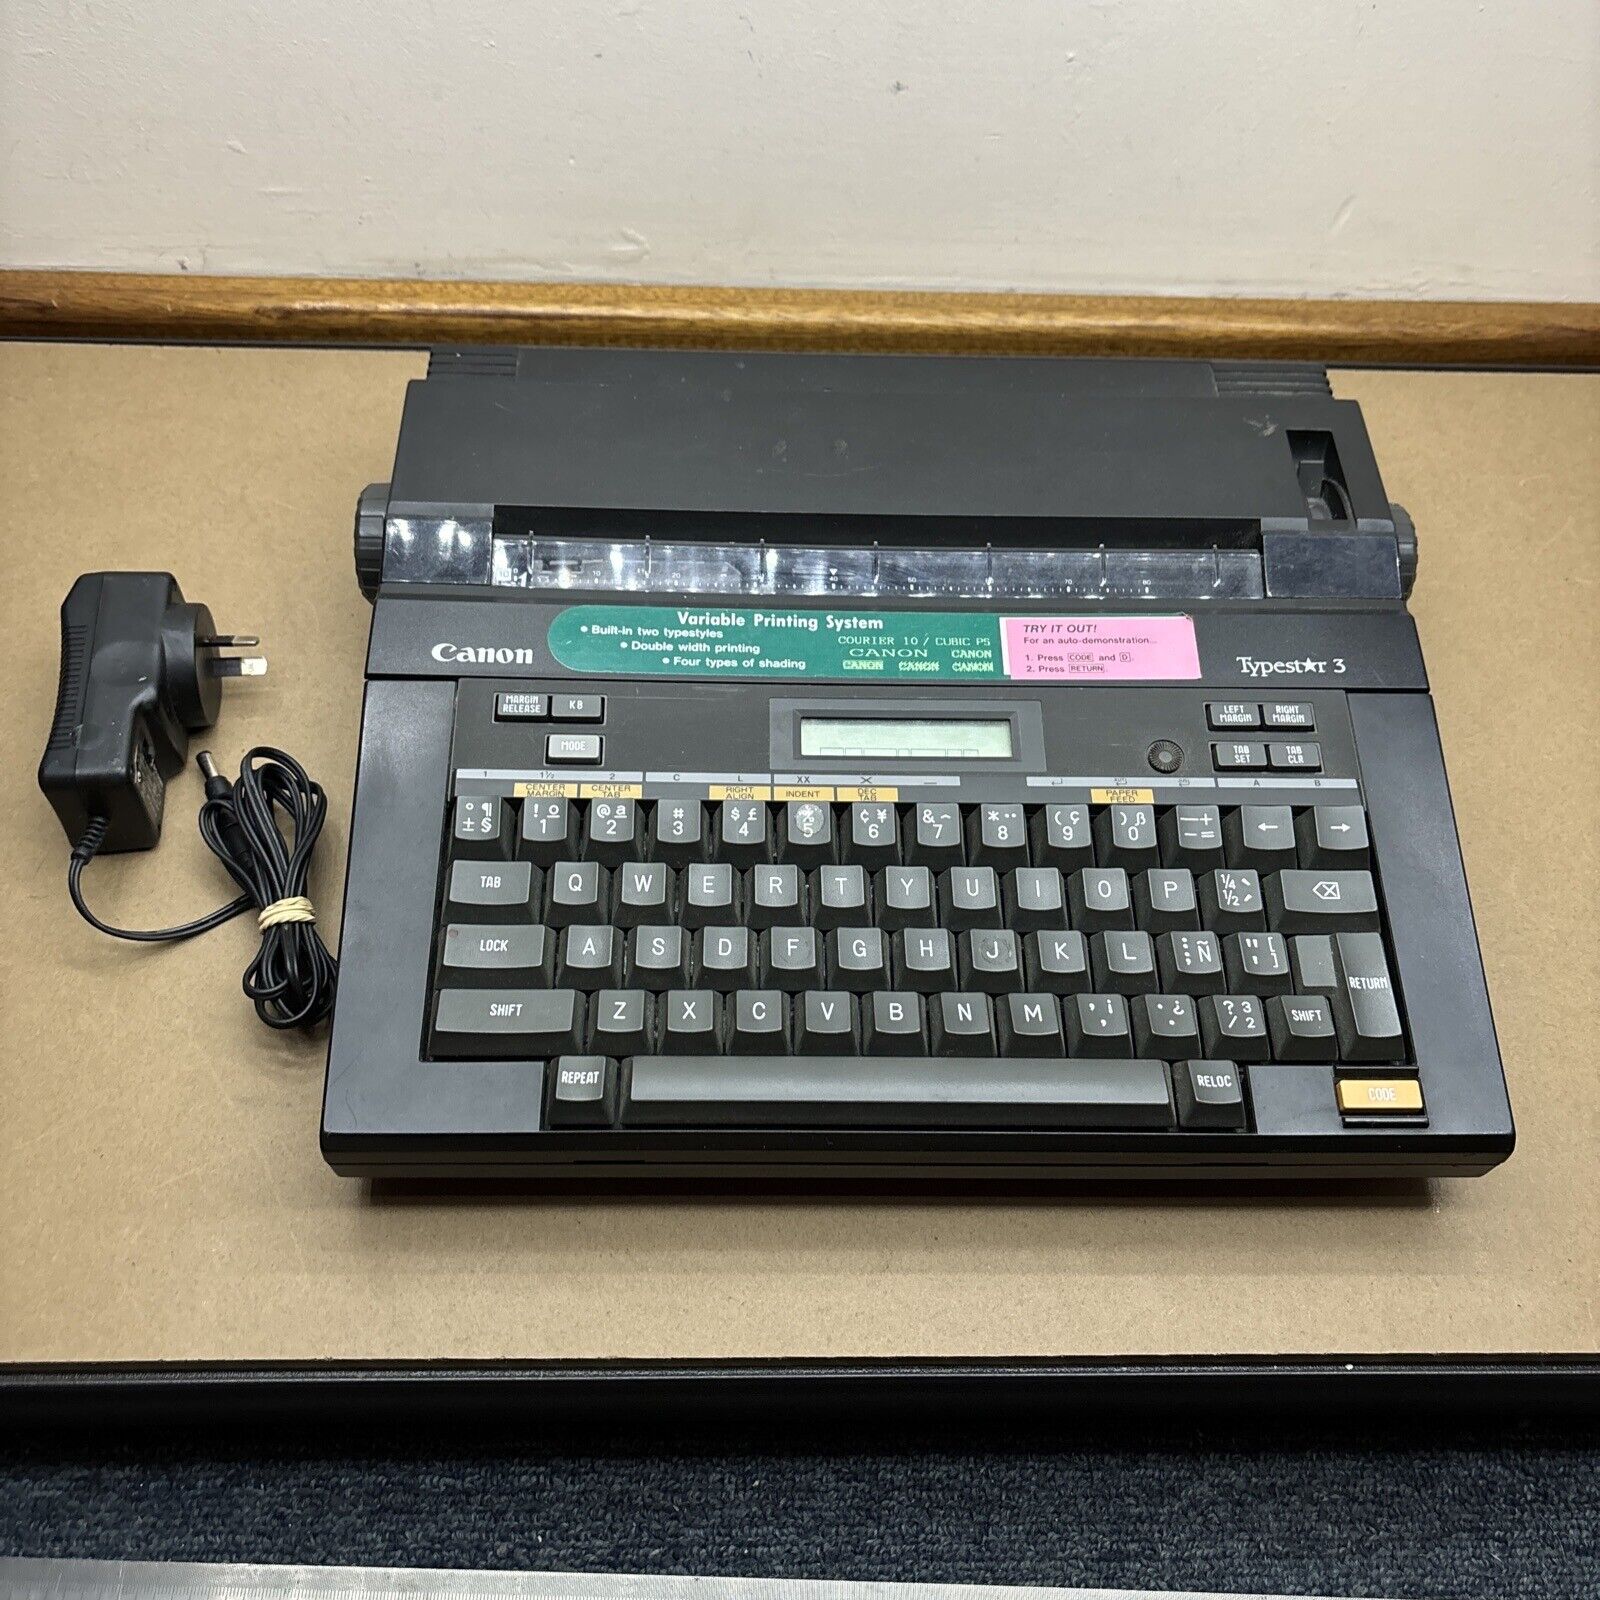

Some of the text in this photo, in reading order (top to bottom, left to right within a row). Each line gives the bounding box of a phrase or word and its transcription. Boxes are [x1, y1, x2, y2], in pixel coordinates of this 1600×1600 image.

[677, 611, 883, 631] Variable Printing System
[592, 625, 723, 639] Built-in two typestyles
[1024, 624, 1097, 633] TRY IT OUT!
[631, 641, 760, 655] Double width printing
[838, 636, 894, 645] COURIER
[904, 637, 918, 646] 10
[936, 637, 970, 646] CUBIC
[976, 638, 991, 646] PS
[432, 643, 533, 665] Canon
[850, 649, 928, 658] CANON
[952, 650, 992, 659] CANON
[673, 657, 806, 670] Four types of shading
[843, 660, 884, 670] CANON
[899, 661, 939, 672] CANON
[952, 662, 994, 672] CANON
[1027, 665, 1035, 673] 2.
[1333, 659, 1346, 673] 3
[506, 695, 538, 704] MARGIN
[503, 704, 541, 713] RELEASE
[1224, 705, 1244, 714] LEFT
[1276, 705, 1299, 714] RIGHT
[1220, 714, 1252, 722] MARGIN
[1273, 714, 1305, 723] MARGIN
[561, 741, 586, 751] MODE
[1233, 745, 1250, 754] TAB
[1286, 746, 1302, 754] TAB
[1235, 755, 1250, 763] SET
[1288, 755, 1304, 764] CLR
[797, 776, 810, 784] XX
[1253, 779, 1260, 787] A
[786, 790, 820, 798] INDENT
[597, 804, 611, 818] @
[673, 808, 684, 819] #
[731, 807, 740, 821] $
[922, 809, 935, 823] &
[540, 819, 547, 834] 1
[607, 820, 617, 835] 2
[673, 822, 684, 836] 3
[739, 822, 749, 836] 4
[803, 823, 813, 838] 5
[868, 824, 879, 839] 6
[933, 824, 943, 839] 7
[997, 826, 1008, 840] 8
[1063, 826, 1073, 841] 9
[480, 876, 501, 888] TAB
[568, 874, 582, 892] Q
[634, 874, 653, 892] W
[703, 876, 715, 894] E
[769, 877, 783, 894] R
[835, 878, 848, 895] T
[901, 879, 914, 896] Y
[966, 879, 979, 897] U
[1036, 880, 1041, 898] I
[1098, 880, 1112, 898] O
[1164, 881, 1178, 899] P
[480, 940, 509, 952] LOCK
[582, 938, 596, 956] A
[652, 938, 665, 956] S
[718, 938, 732, 956] D
[787, 939, 800, 957] F
[852, 940, 867, 957] G
[920, 940, 934, 957] H
[986, 941, 999, 959] J
[1055, 942, 1070, 960] K
[1122, 943, 1137, 960] L
[1197, 940, 1212, 962] Ñ
[1349, 977, 1388, 989] RETURN
[489, 1004, 523, 1017] SHIFT
[613, 1002, 626, 1020] Z
[682, 1002, 697, 1020] X
[752, 1002, 766, 1020] C
[820, 1002, 834, 1021] V
[889, 1003, 904, 1021] B
[958, 1003, 972, 1022] N
[1024, 1004, 1043, 1022] M
[1223, 1001, 1234, 1015] ?
[1291, 1010, 1322, 1022] SHIFT
[561, 1071, 600, 1085] REPEAT
[1197, 1075, 1232, 1088] RELOC
[1367, 1088, 1397, 1101] CODE
